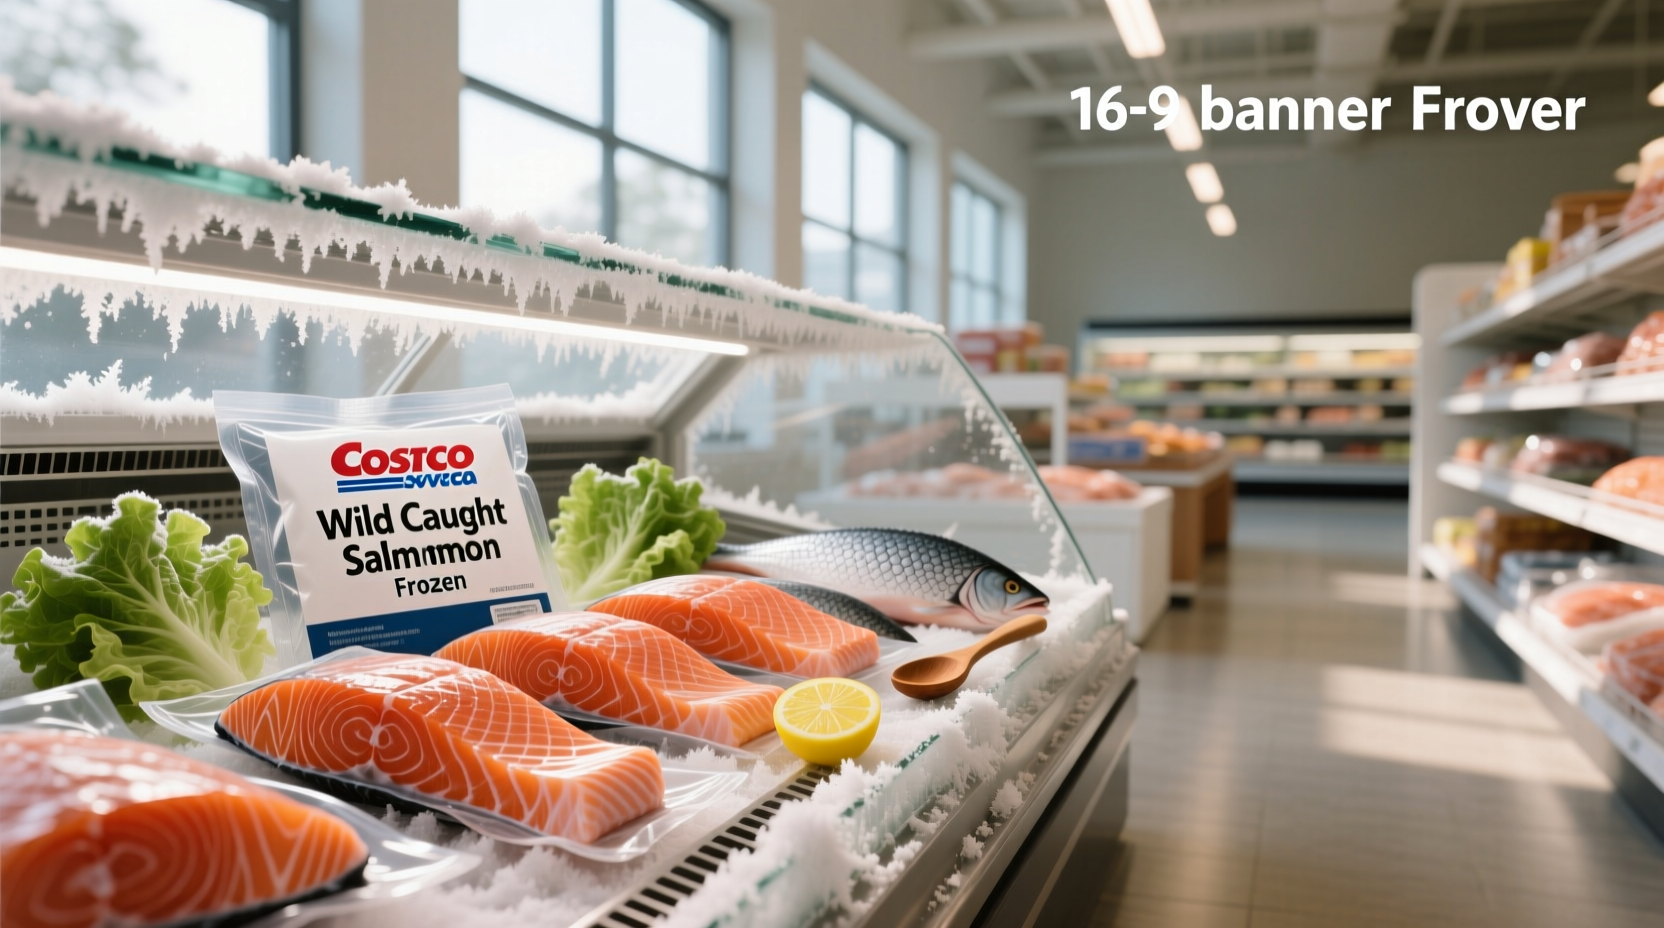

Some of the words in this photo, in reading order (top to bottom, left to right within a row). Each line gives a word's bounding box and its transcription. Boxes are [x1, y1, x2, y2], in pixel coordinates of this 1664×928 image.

[316, 502, 395, 541] Wild
[400, 496, 508, 536] Caught
[394, 574, 468, 598] Frozen
